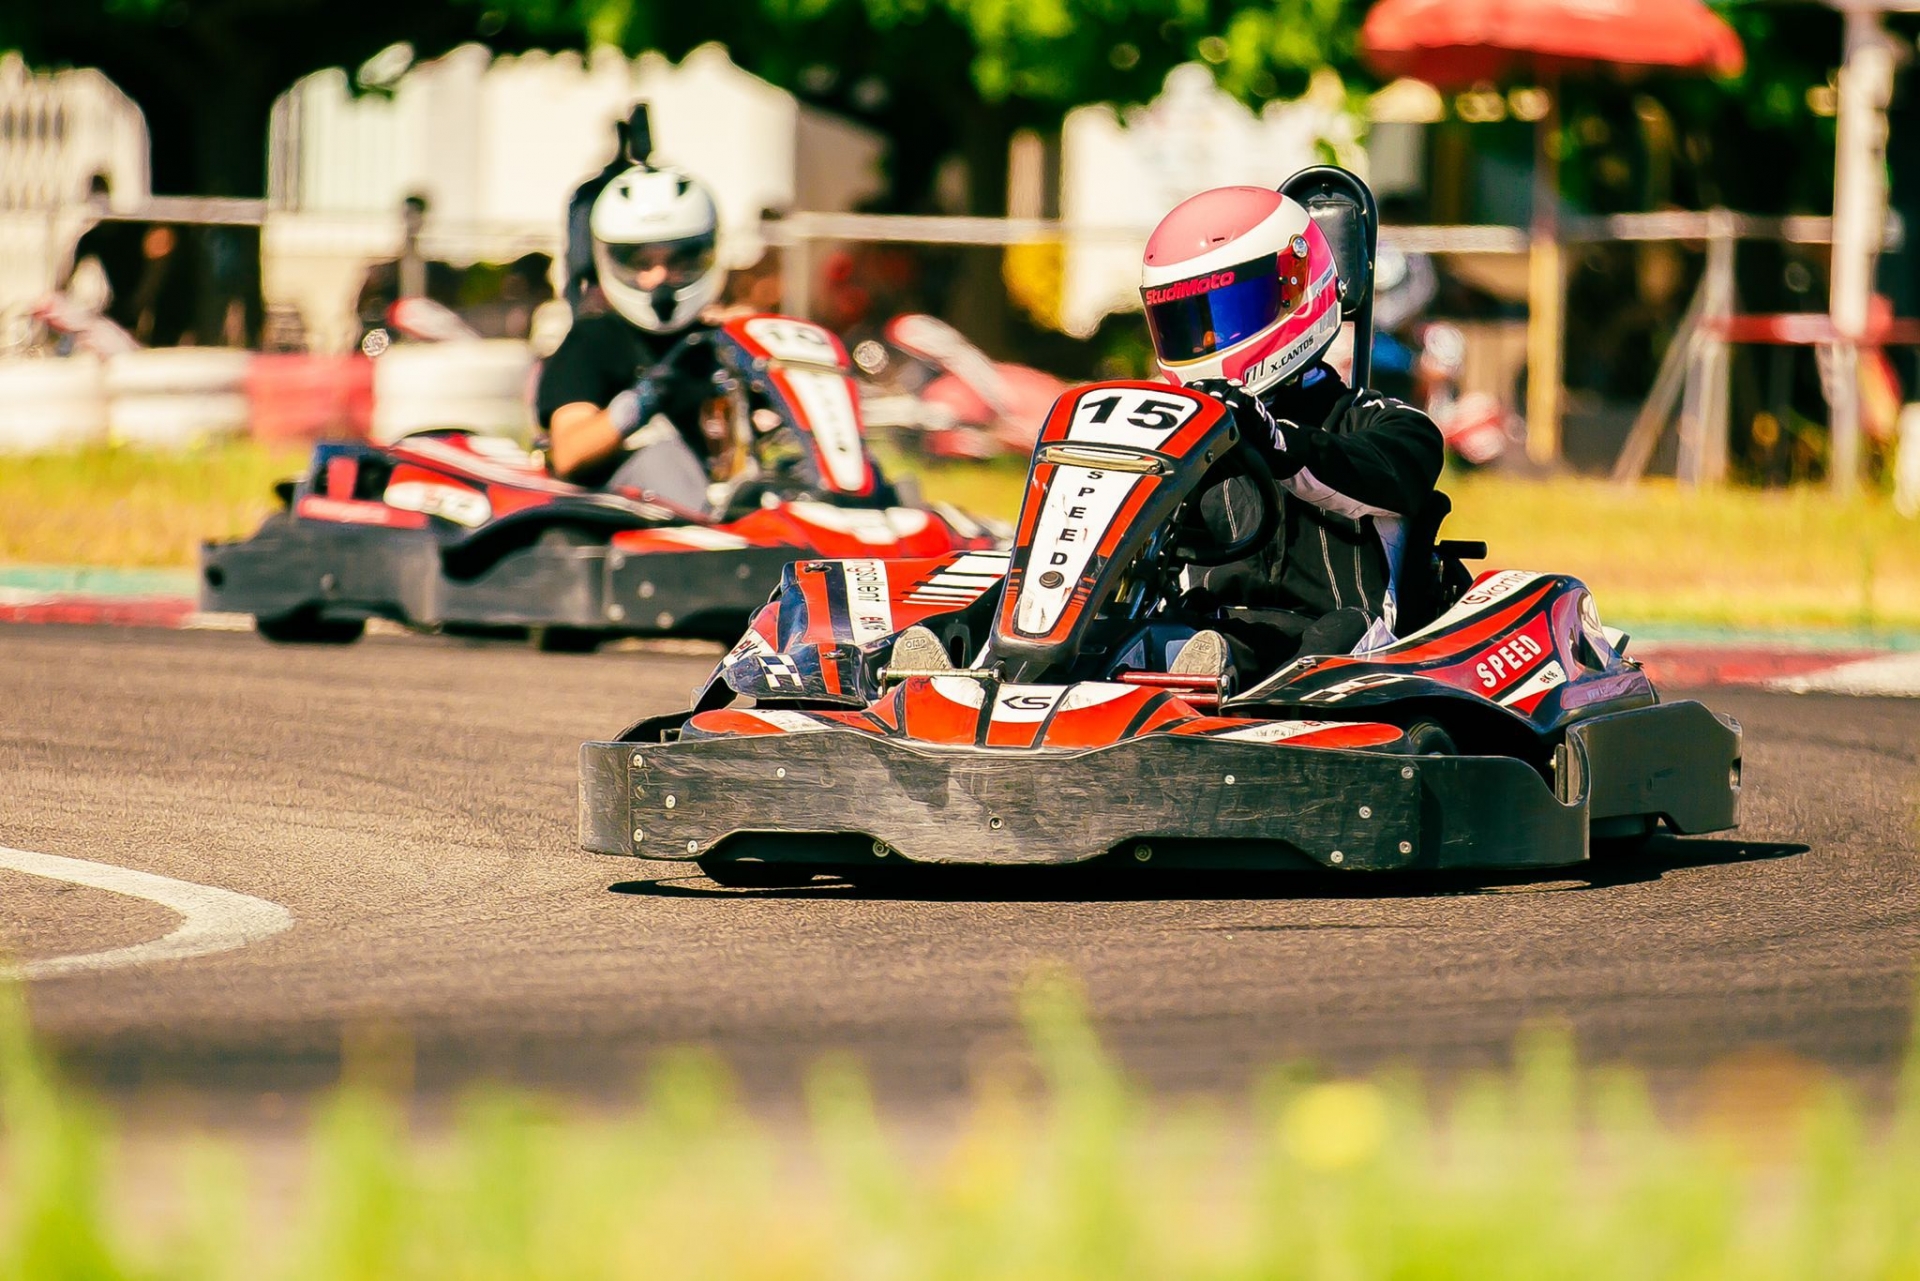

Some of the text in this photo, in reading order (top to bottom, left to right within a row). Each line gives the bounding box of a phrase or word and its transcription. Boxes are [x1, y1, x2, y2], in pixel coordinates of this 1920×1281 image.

[1270, 335, 1314, 373] X.CANTOS
[1082, 396, 1184, 429] 15
[1050, 470, 1103, 566] SPEED
[1476, 635, 1541, 688] SPEED
